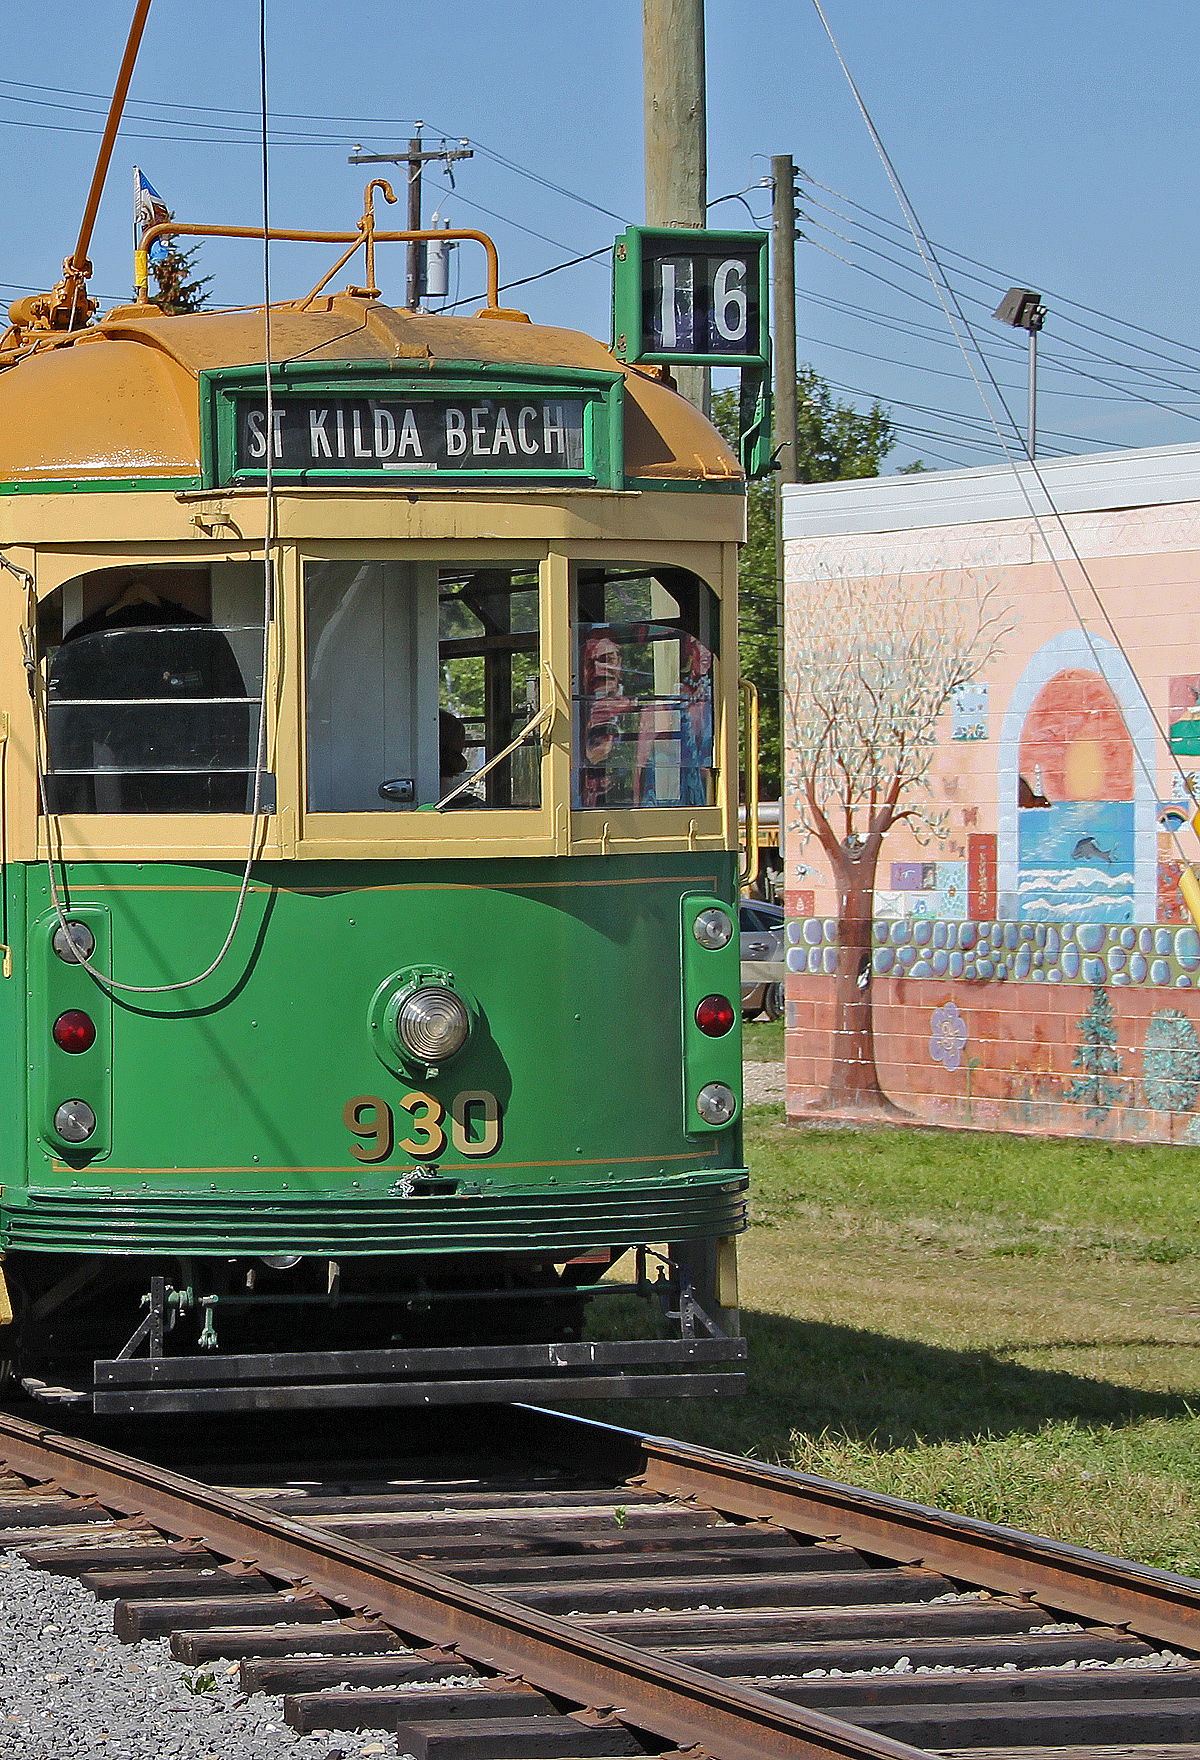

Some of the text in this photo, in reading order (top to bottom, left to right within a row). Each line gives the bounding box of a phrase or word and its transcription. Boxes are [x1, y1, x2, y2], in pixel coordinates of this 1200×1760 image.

[661, 259, 748, 348] 16
[247, 406, 565, 459] ST KILDA BEACH
[341, 1090, 504, 1164] 930
